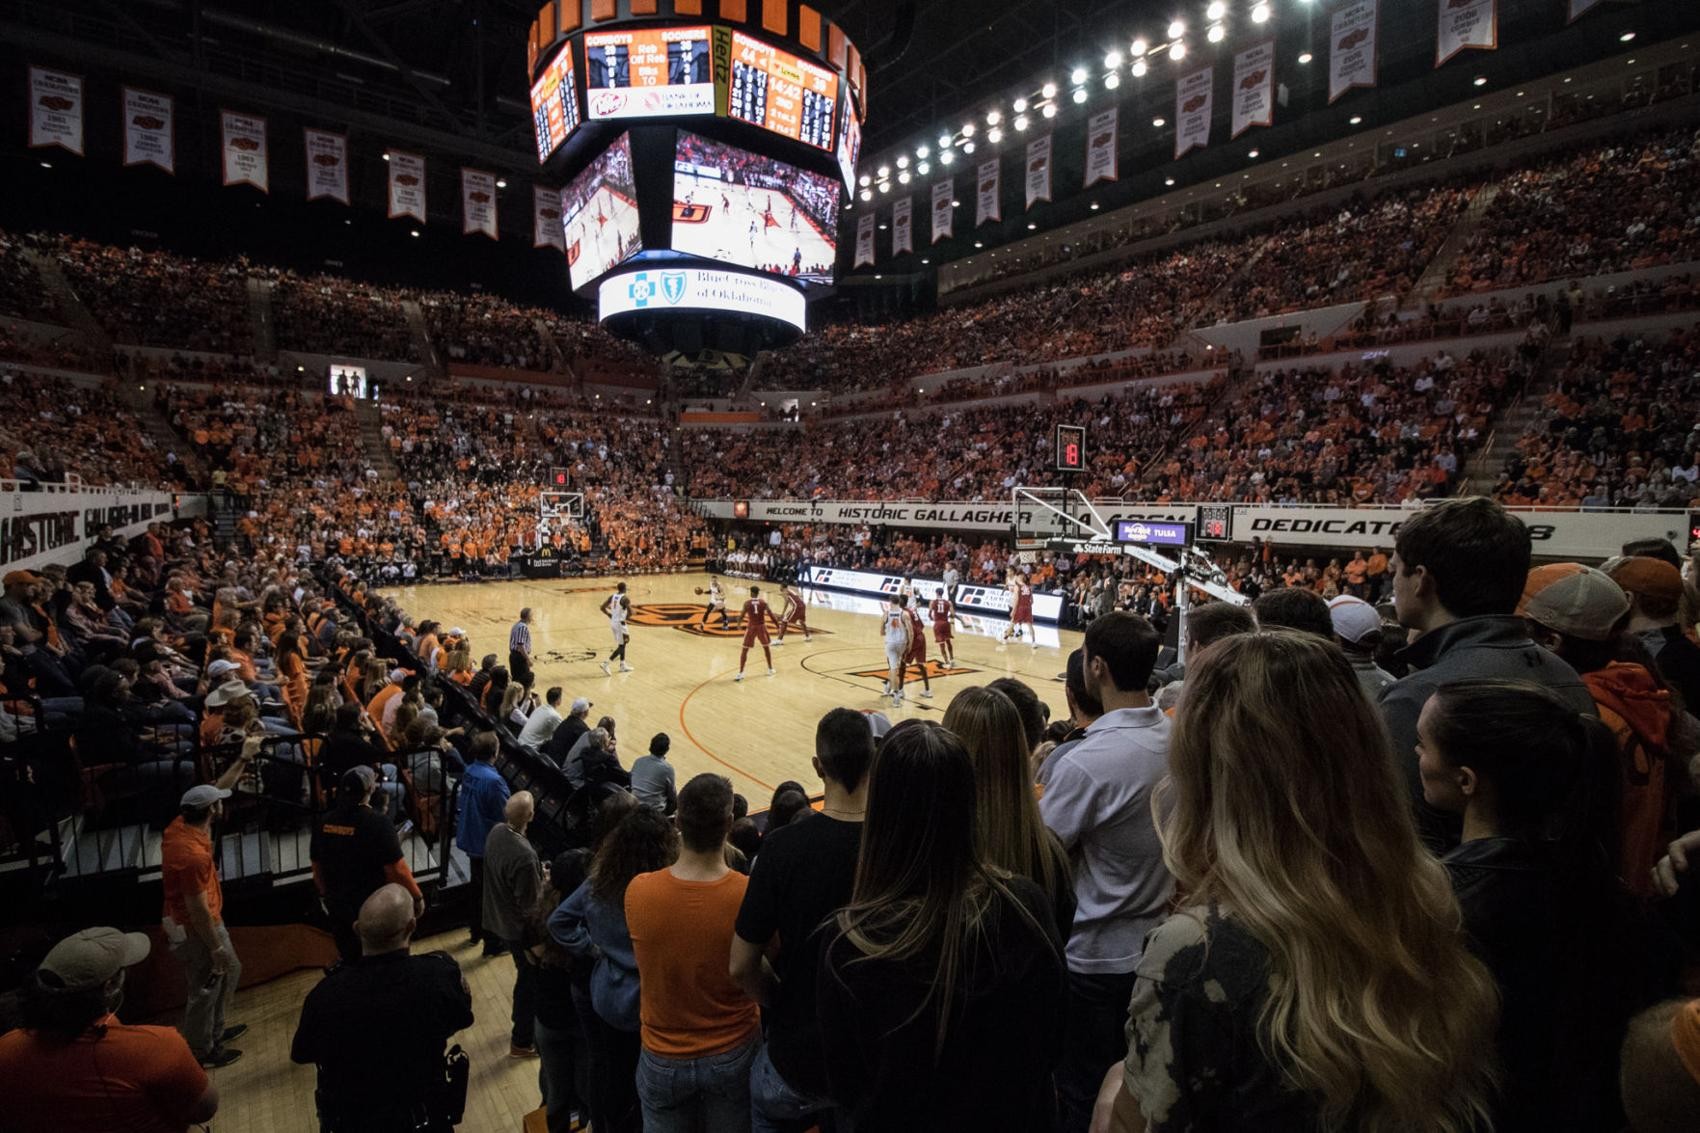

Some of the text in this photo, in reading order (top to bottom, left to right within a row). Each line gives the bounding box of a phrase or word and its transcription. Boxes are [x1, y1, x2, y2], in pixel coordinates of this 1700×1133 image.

[715, 29, 728, 84] Hertz
[766, 507, 823, 516] WELCOME TO
[838, 508, 909, 520] HISTORIC
[914, 509, 1032, 524] GALLAGHER
[1154, 529, 1176, 538] TULSA
[937, 604, 944, 613] 11
